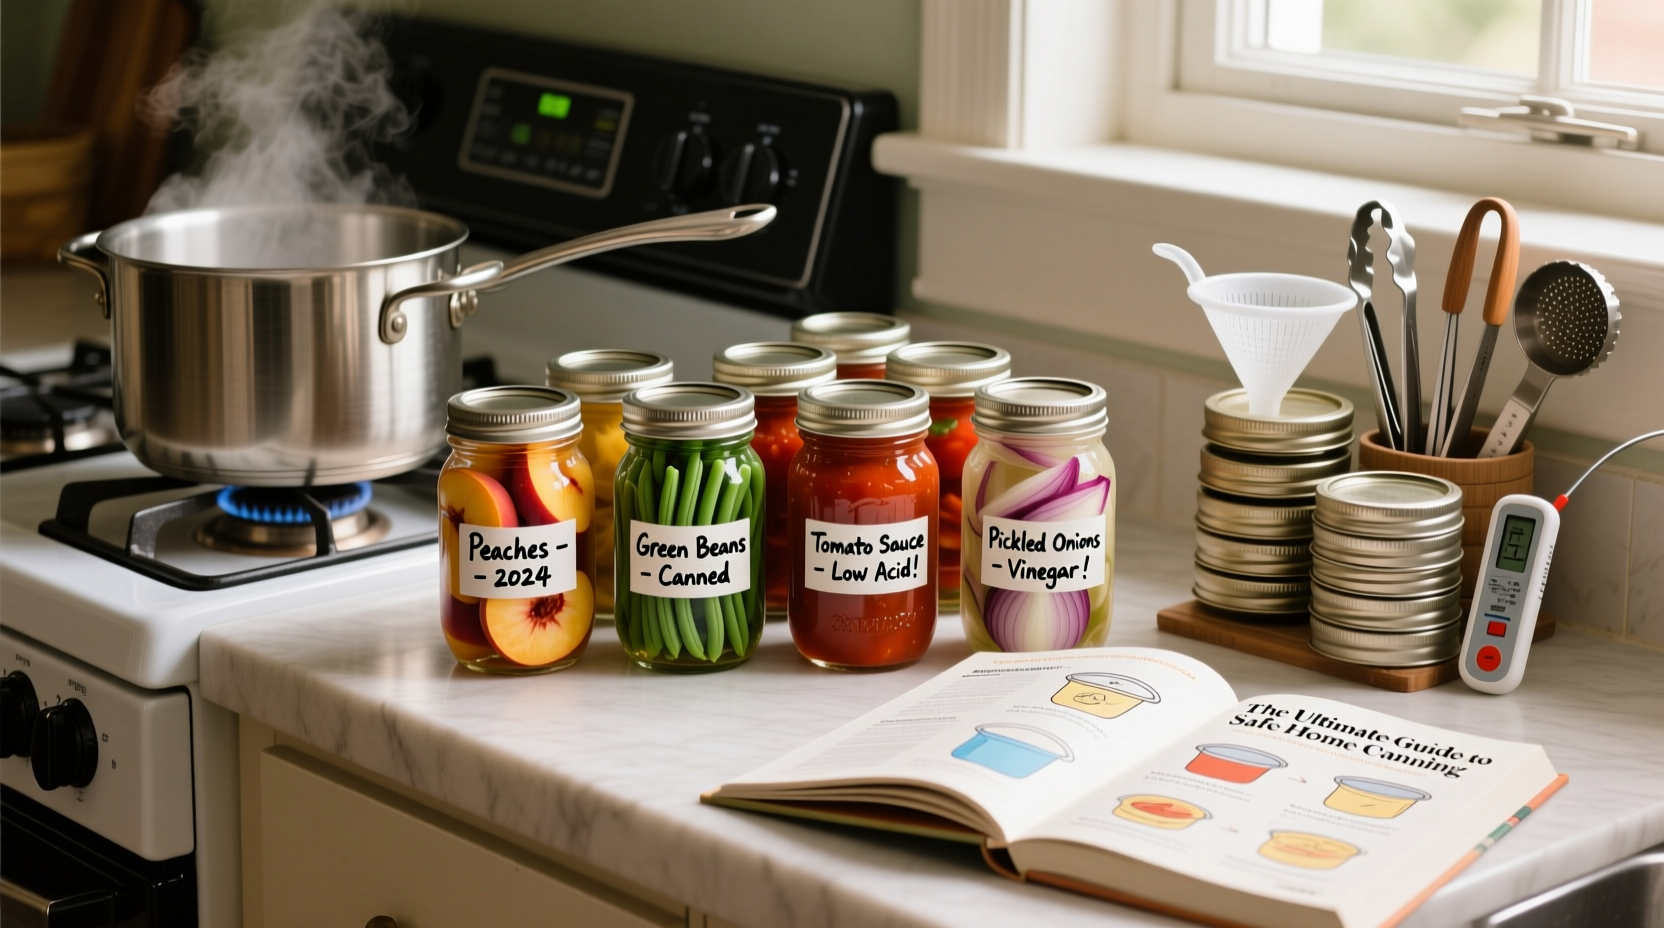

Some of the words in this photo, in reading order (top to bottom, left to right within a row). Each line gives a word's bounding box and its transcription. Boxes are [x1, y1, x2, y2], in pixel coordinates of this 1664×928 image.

[469, 531, 549, 561] Peaches
[635, 532, 688, 559] Green
[696, 535, 747, 560] Beans
[810, 531, 874, 555] Tomato
[879, 533, 925, 555] Sauce
[988, 526, 1047, 553] Pickled
[1052, 531, 1101, 552] Onions
[493, 565, 552, 588] 2024
[658, 560, 731, 587] Canned
[831, 560, 869, 582] Low
[874, 554, 919, 582] Acid!
[1229, 713, 1282, 732] Safe
[1283, 723, 1358, 751] Home
[1362, 743, 1468, 779] Canning
[1247, 703, 1290, 717] The
[1294, 708, 1390, 742] Ultimate
[1393, 735, 1464, 761] Guide
[1468, 753, 1493, 766] to
